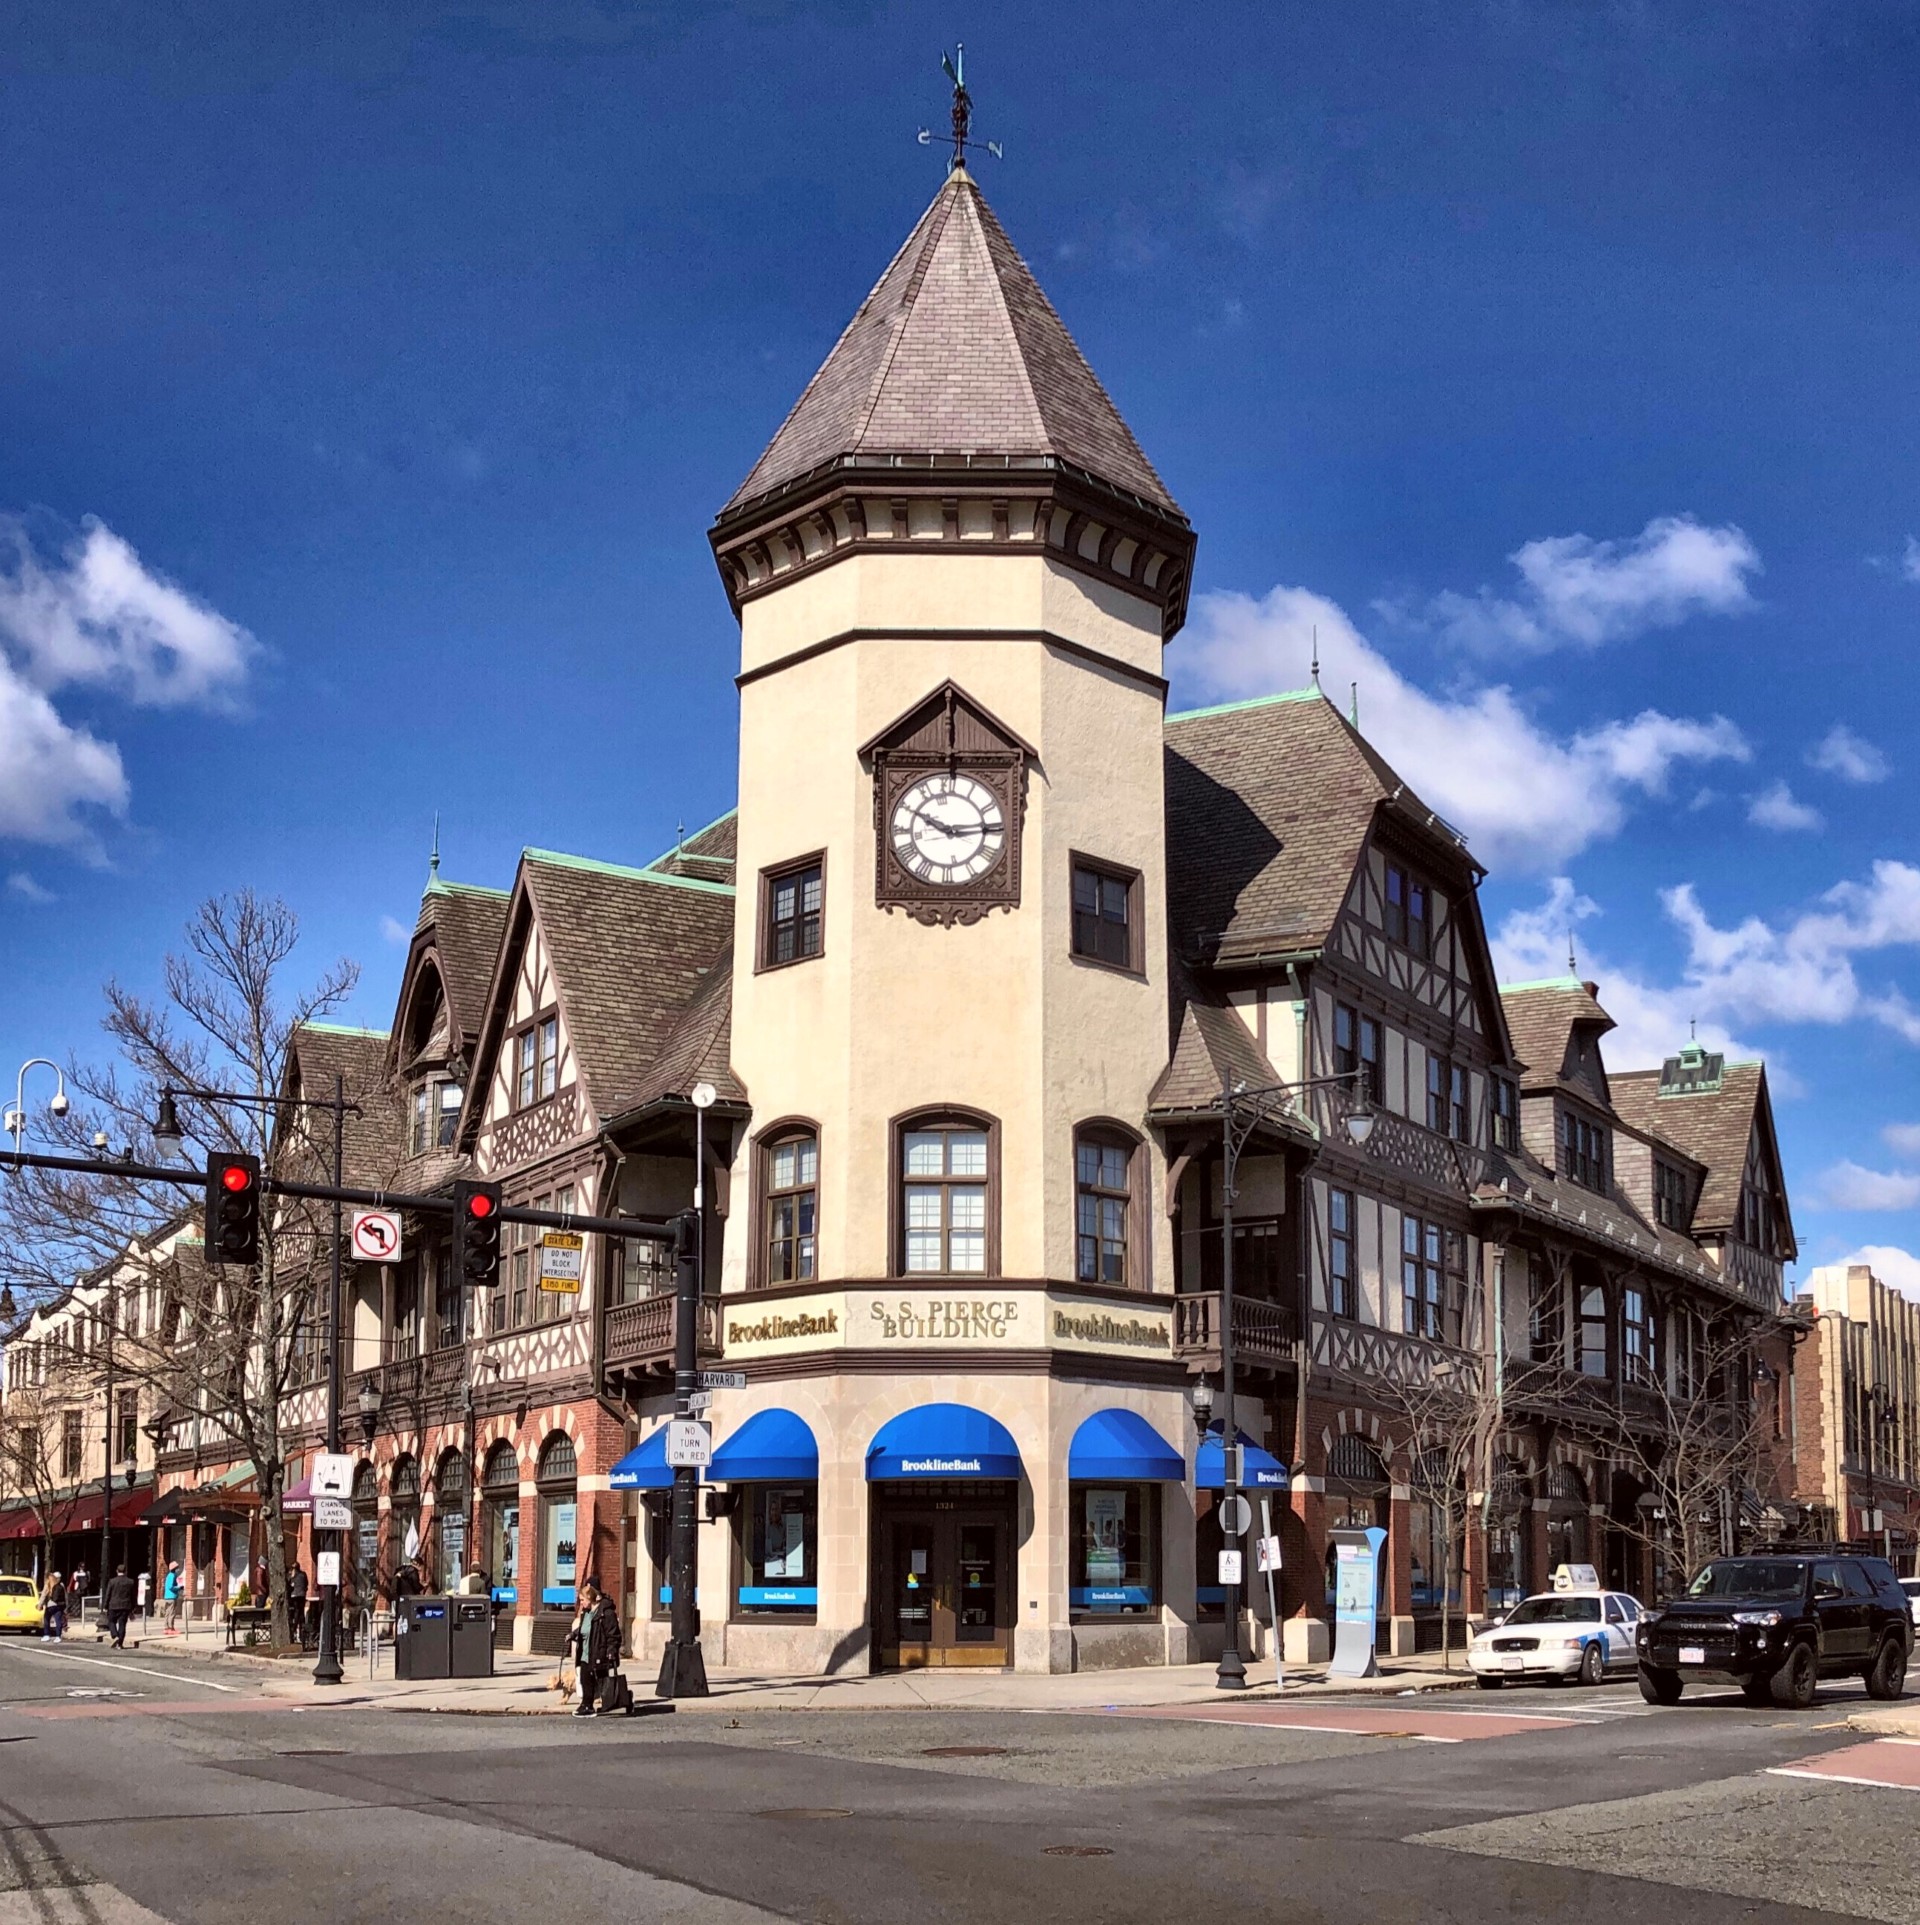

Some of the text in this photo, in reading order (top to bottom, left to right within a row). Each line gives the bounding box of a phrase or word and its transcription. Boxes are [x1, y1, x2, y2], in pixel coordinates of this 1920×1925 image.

[548, 1236, 564, 1246] STATE
[552, 1259, 571, 1268] BLOCK
[542, 1268, 578, 1277] INTERSECTION
[561, 1281, 575, 1290] FINE
[929, 1301, 1019, 1320] PIERCE
[727, 1308, 839, 1344] BrooklineBank
[882, 1318, 1007, 1339] BUILDING
[1053, 1310, 1170, 1346] BrooklineBank
[698, 1372, 735, 1387] HARVARD
[685, 1426, 696, 1435] NO
[680, 1438, 700, 1448] TURN
[673, 1451, 706, 1461] ON RED
[902, 1459, 981, 1472] BrooklineBank
[283, 1501, 311, 1509] MARKET
[320, 1500, 347, 1508] CHANGE
[323, 1509, 344, 1517] LANES
[320, 1518, 347, 1526] TO PASS
